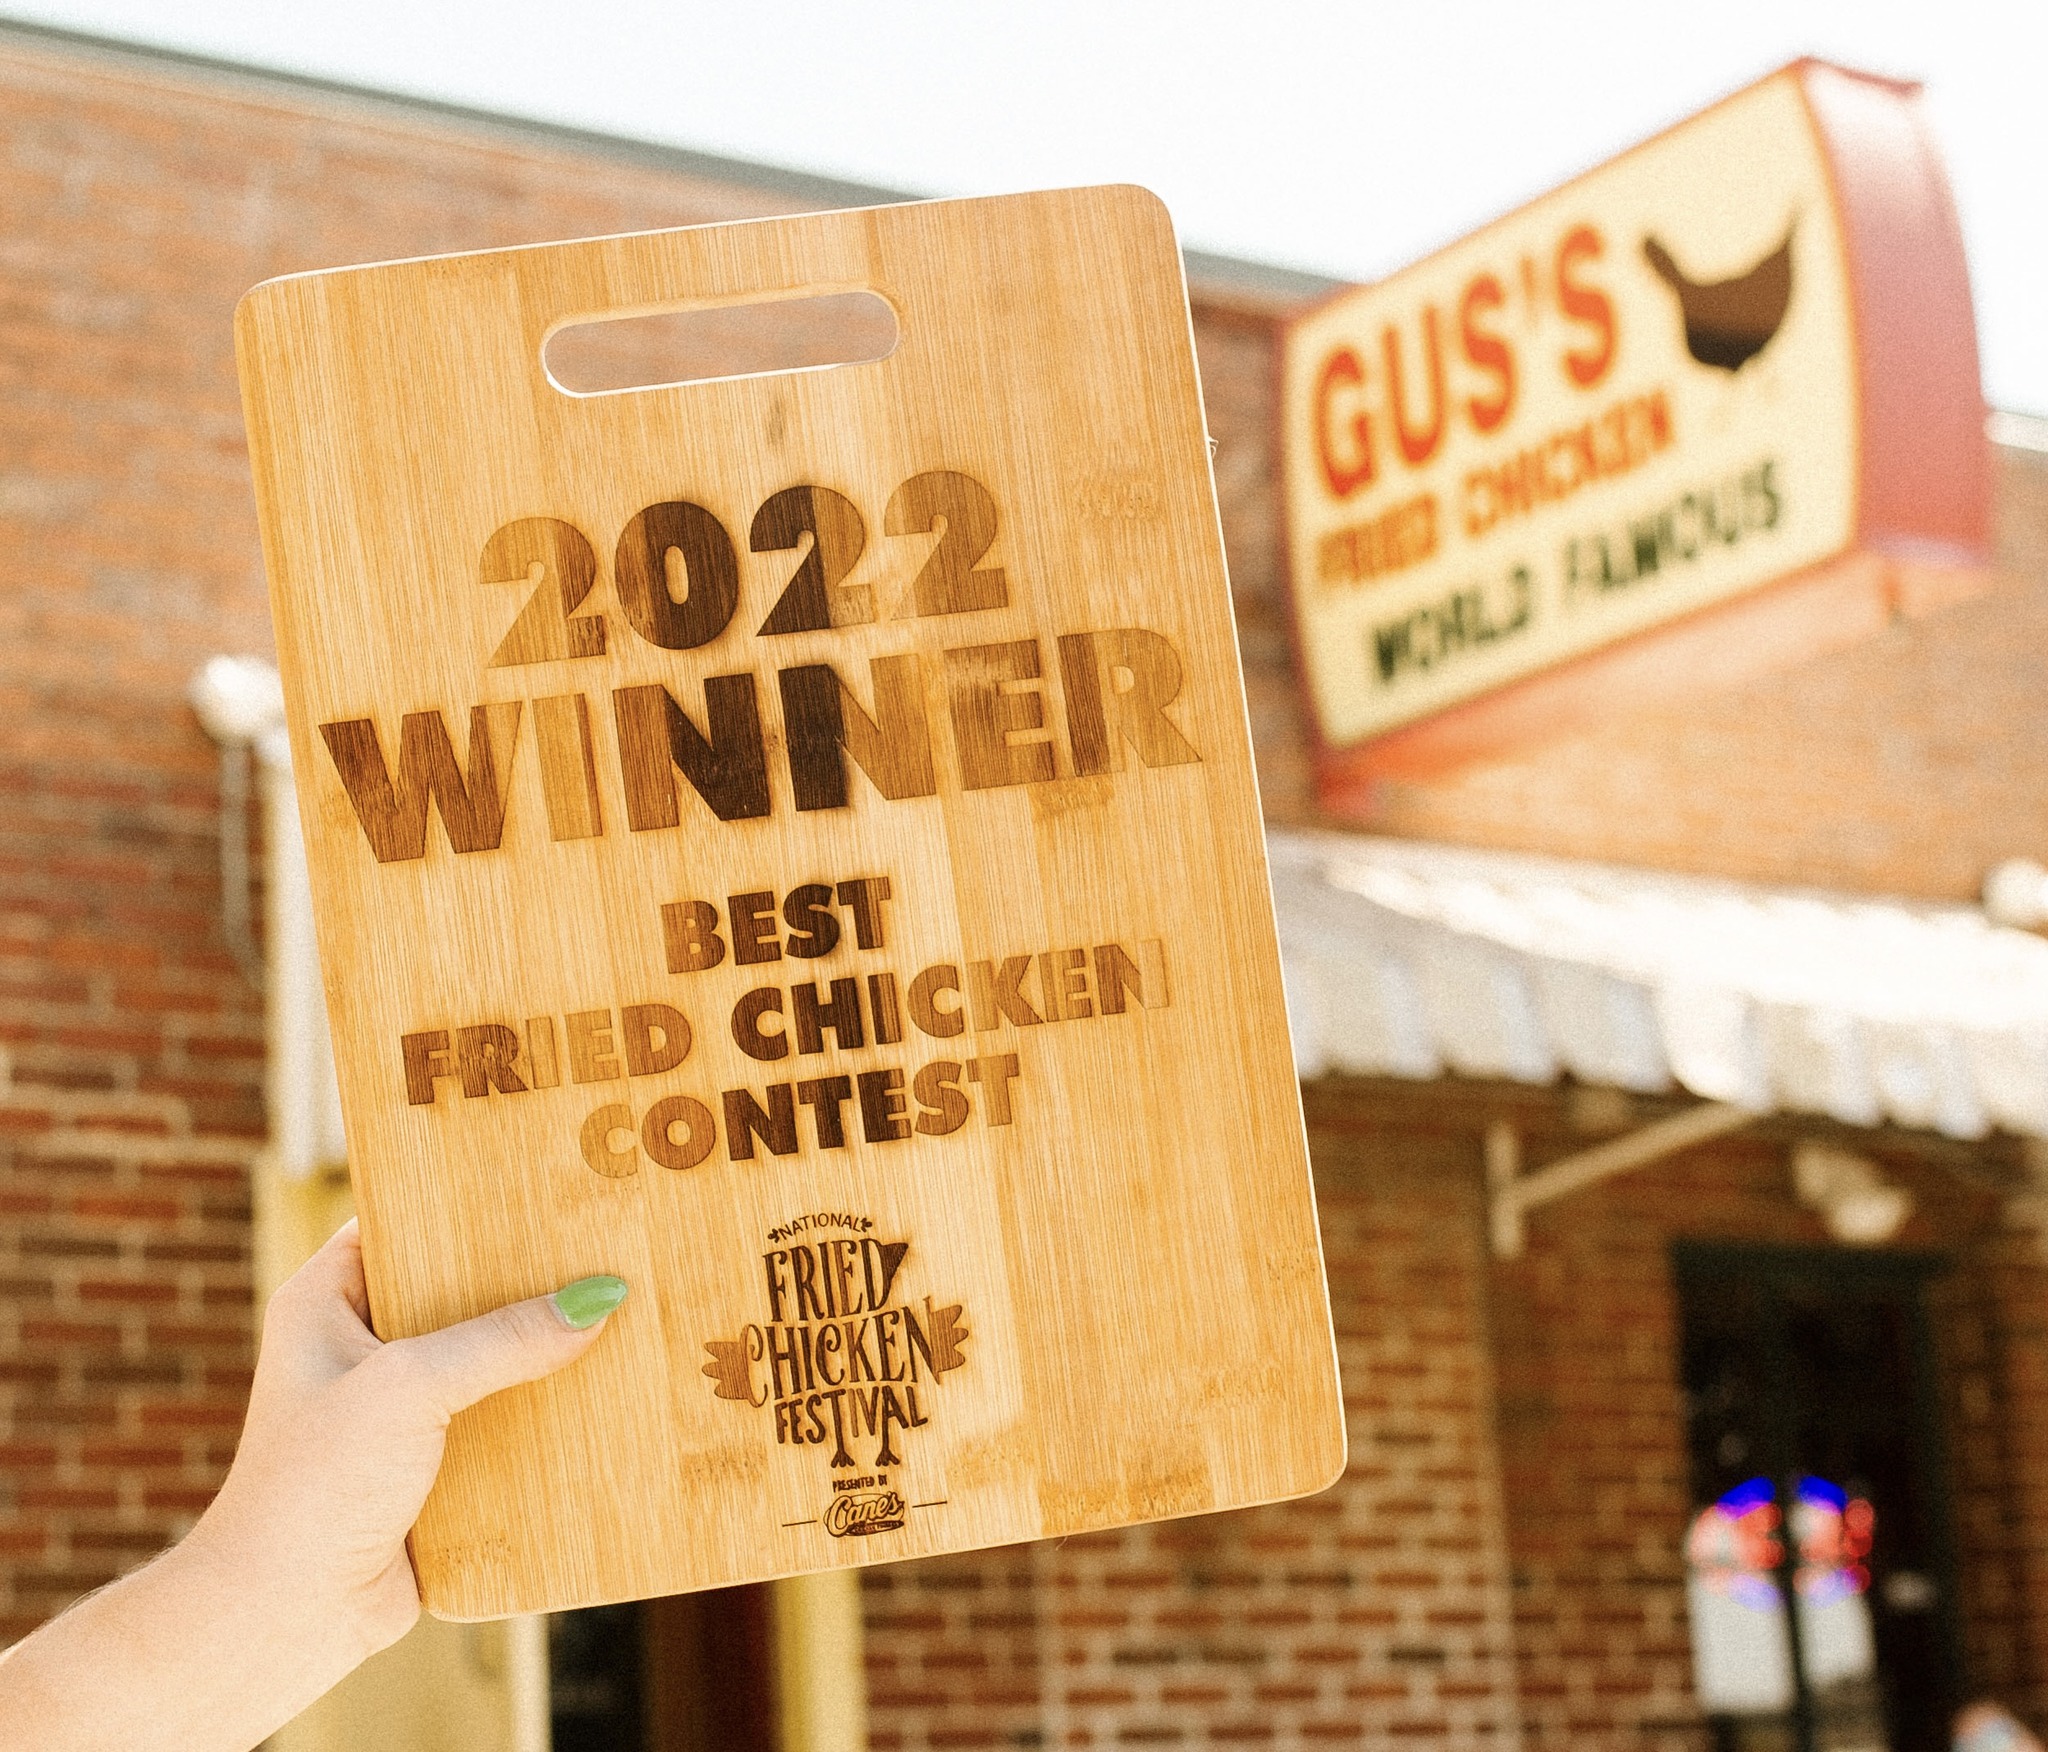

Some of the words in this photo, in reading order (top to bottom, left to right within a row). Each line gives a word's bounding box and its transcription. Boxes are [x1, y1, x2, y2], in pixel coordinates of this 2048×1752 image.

[1313, 222, 1619, 499] GUS'S
[479, 470, 1009, 668] 2022
[318, 628, 1203, 863] WINNER
[660, 876, 891, 974] BEST
[400, 1003, 692, 1105] FRIED
[731, 938, 1169, 1061] CHICKEN
[580, 1053, 1020, 1178] CONTEST
[777, 1212, 862, 1241] NATIONAL
[763, 1238, 909, 1322] FRIED
[739, 1296, 942, 1408] CHICKEN
[774, 1385, 929, 1457] FESTIVAL
[827, 1490, 902, 1538] Cane's
[833, 1476, 875, 1493] PRESENTED
[878, 1474, 888, 1486] BY
